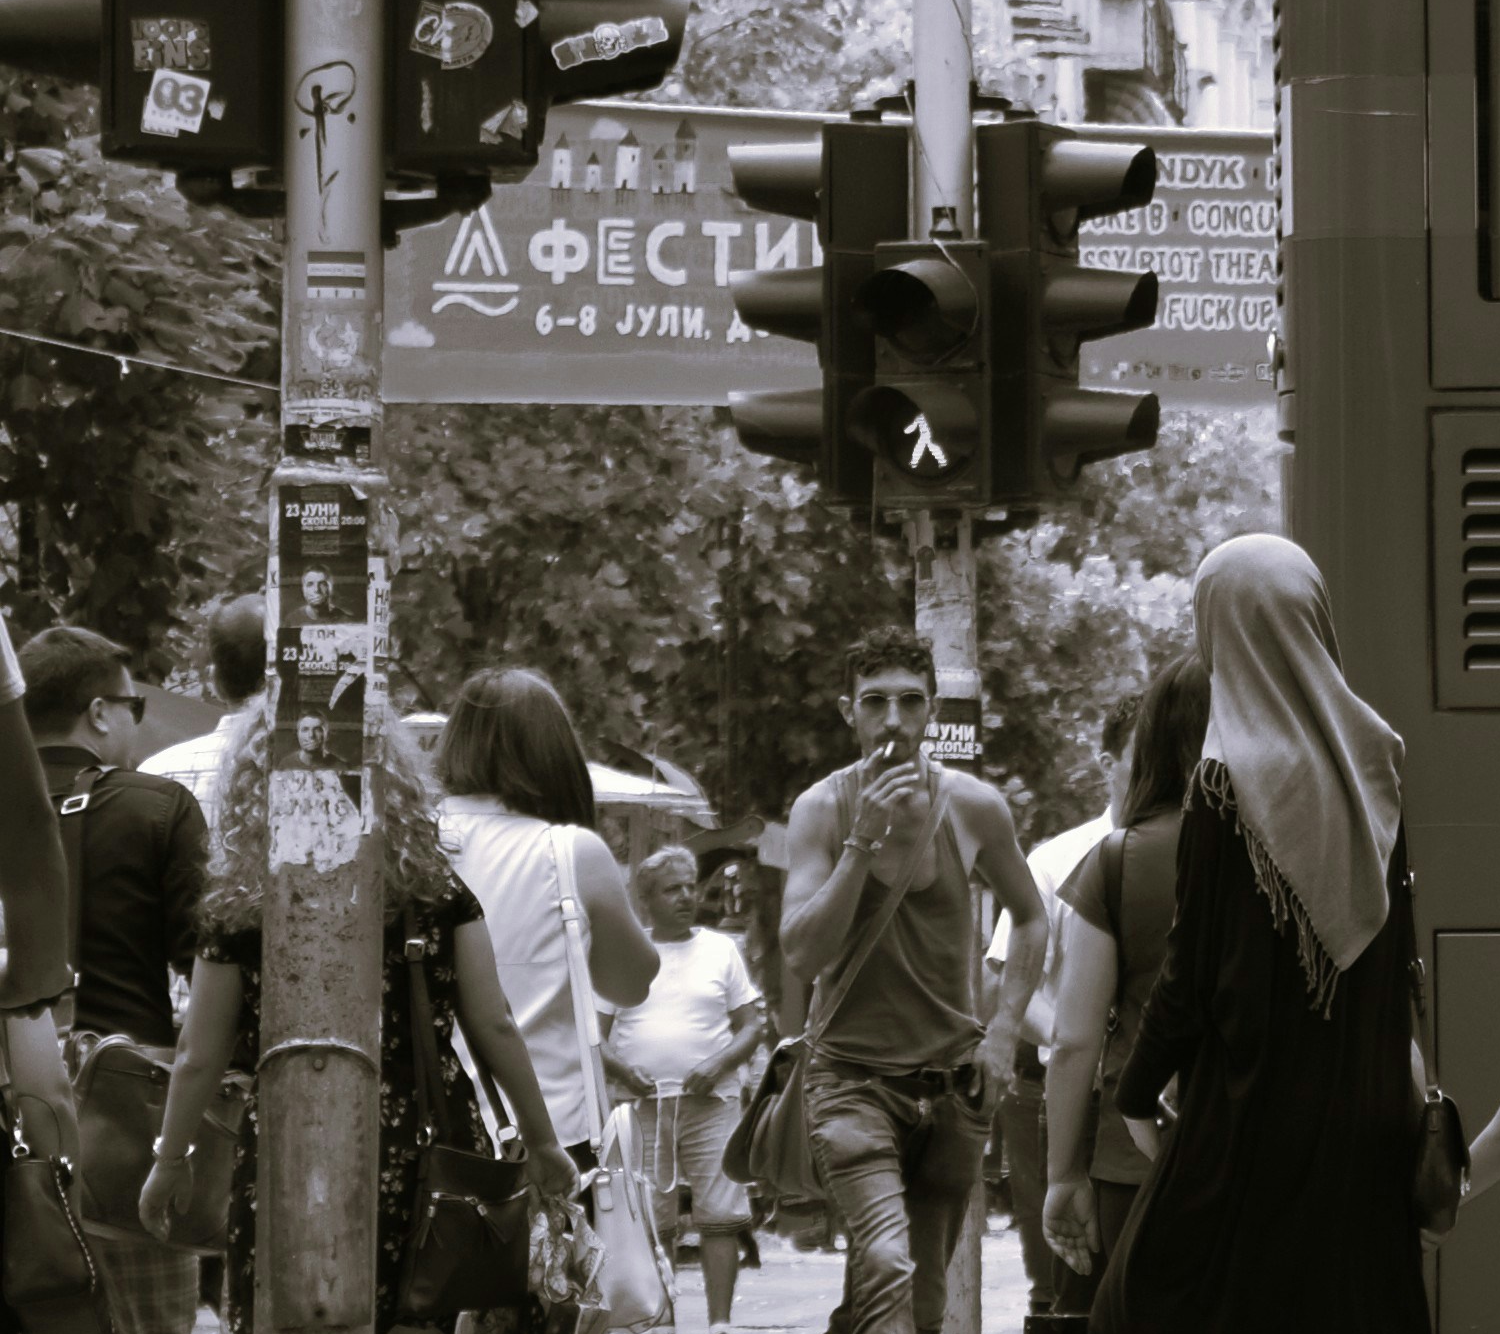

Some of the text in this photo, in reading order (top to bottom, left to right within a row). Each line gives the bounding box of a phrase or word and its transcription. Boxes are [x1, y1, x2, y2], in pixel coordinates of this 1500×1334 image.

[1156, 156, 1243, 186] NDYK
[1191, 203, 1276, 233] CONQU
[527, 218, 824, 287] ФЕСТИ
[1083, 249, 1127, 269] SSY
[1213, 251, 1275, 280] THEA
[1168, 297, 1231, 327] FUCK
[301, 503, 341, 517] ЈУНИ
[935, 740, 974, 754] КОПЈЕ
[939, 723, 976, 742] УНИ
